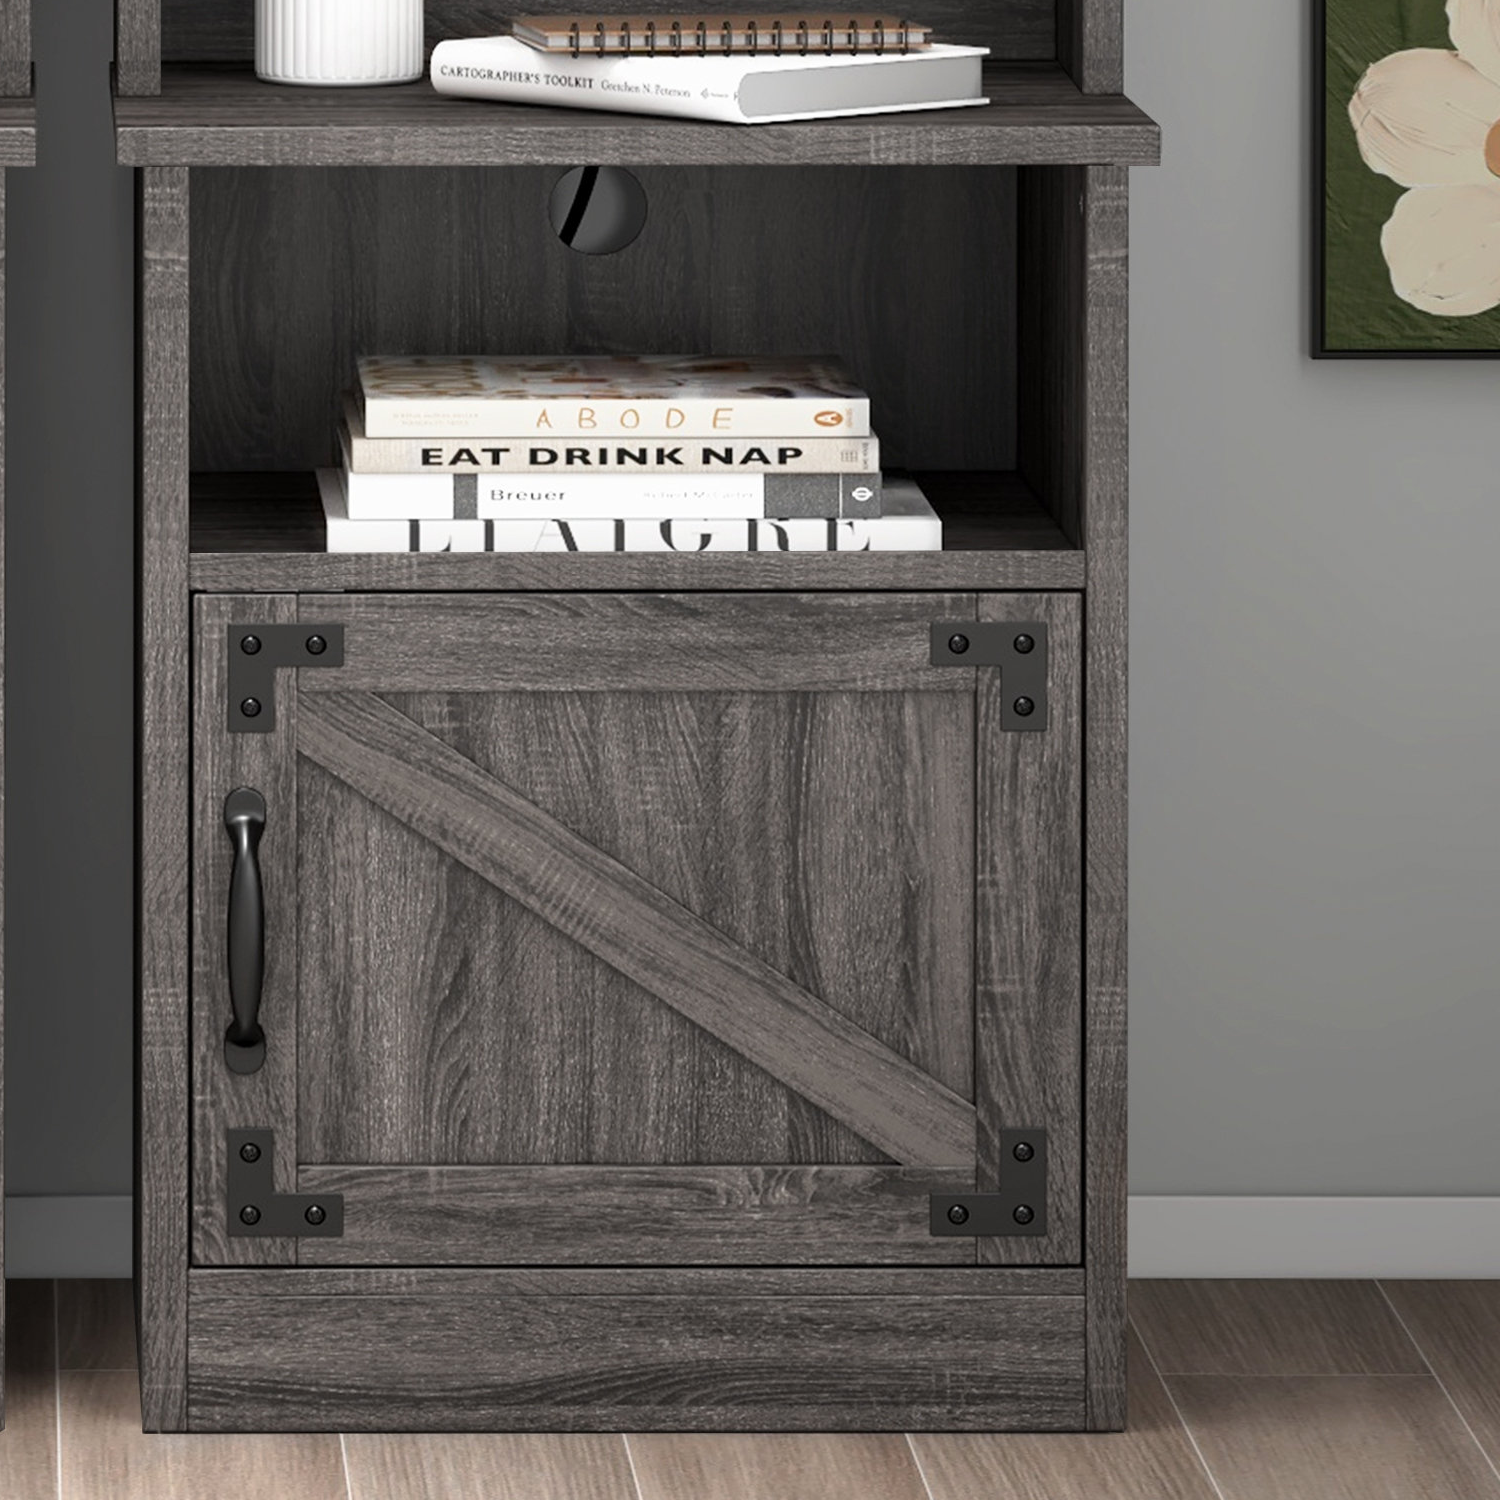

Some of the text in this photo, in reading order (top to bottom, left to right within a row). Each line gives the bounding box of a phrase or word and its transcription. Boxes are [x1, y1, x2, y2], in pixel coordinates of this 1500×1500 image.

[440, 65, 541, 85] CARTOGRAPHER'S
[544, 74, 594, 90] TOOLKIT
[536, 407, 734, 429] ABODE
[421, 447, 803, 466] EAT DRINK NAP
[490, 489, 566, 501] Breuer
